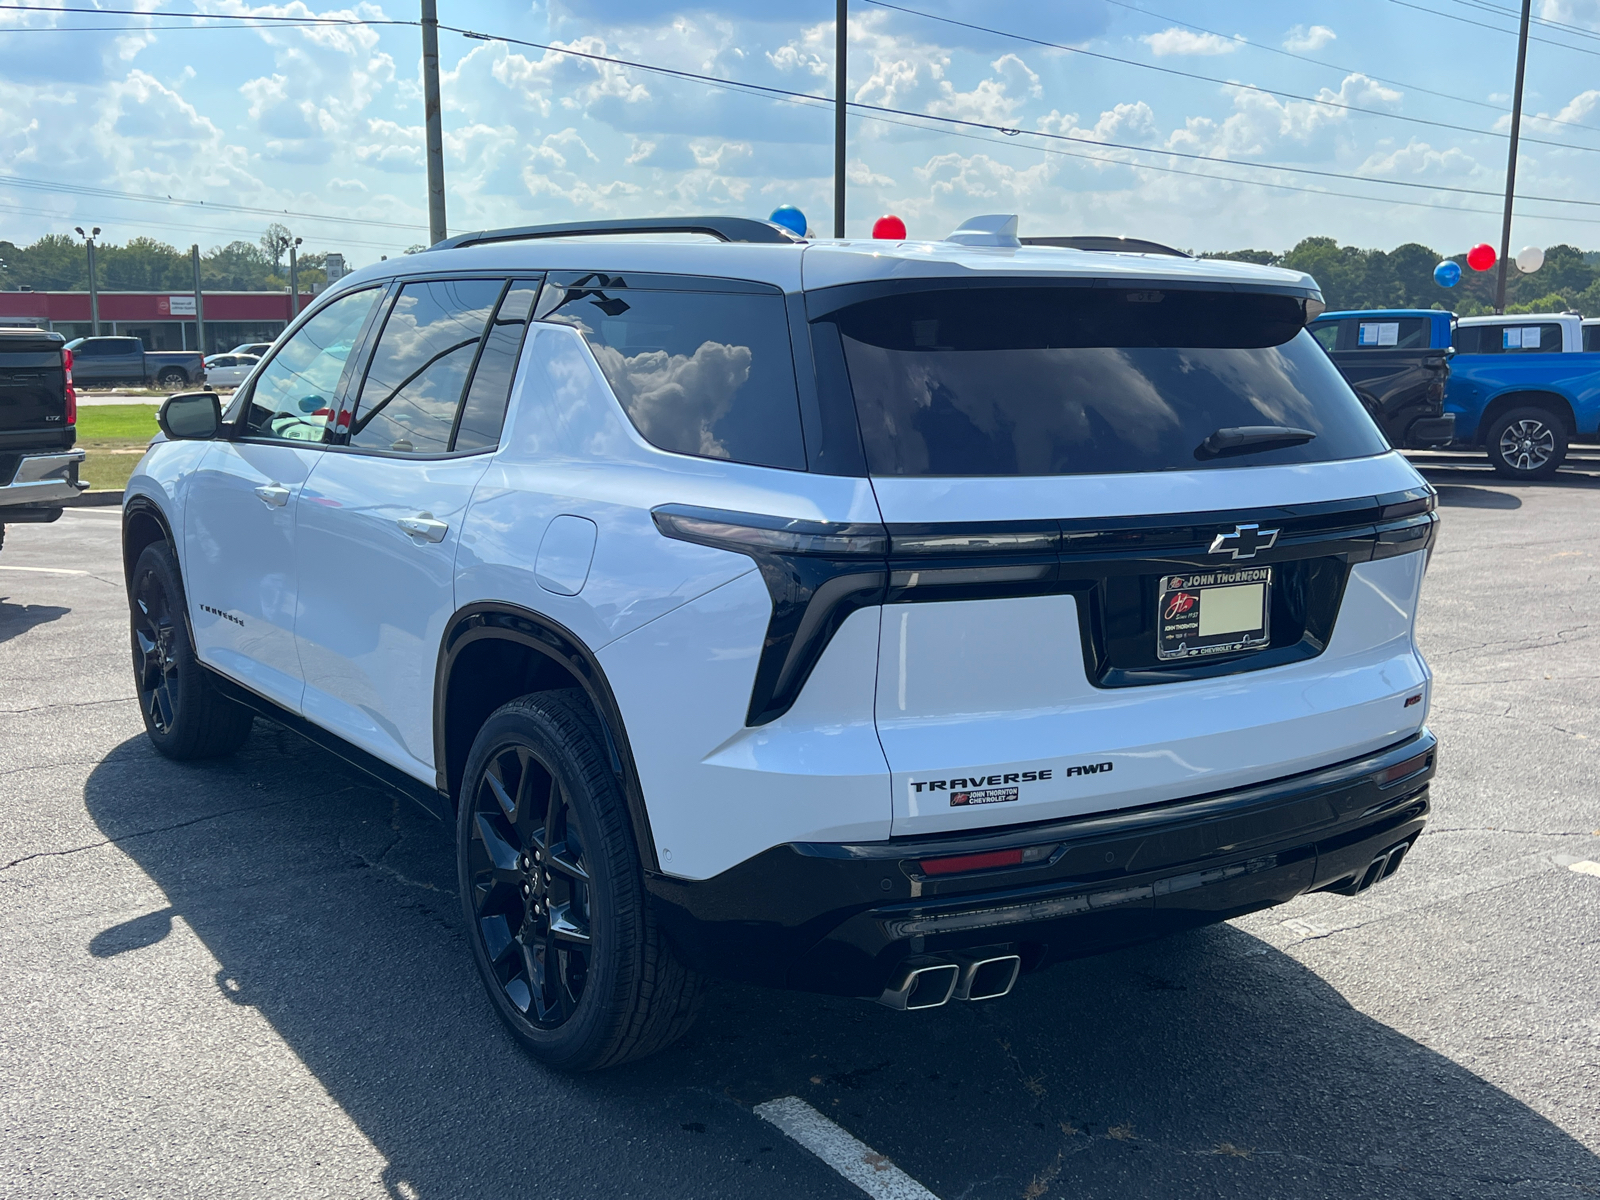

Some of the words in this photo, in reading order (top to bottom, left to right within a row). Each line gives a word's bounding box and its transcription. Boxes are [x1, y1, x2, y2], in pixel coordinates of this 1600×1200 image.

[1188, 575, 1215, 587] JOHN
[1217, 570, 1268, 583] THORNTON
[199, 604, 244, 627] TRAVERSE
[1201, 646, 1232, 654] CHEVROLET
[911, 769, 1052, 793] TRAVERSE
[1066, 762, 1114, 777] AWD
[968, 796, 1006, 805] CHEVROLET
[969, 790, 986, 799] JOHN
[986, 788, 1018, 797] THORNTON
